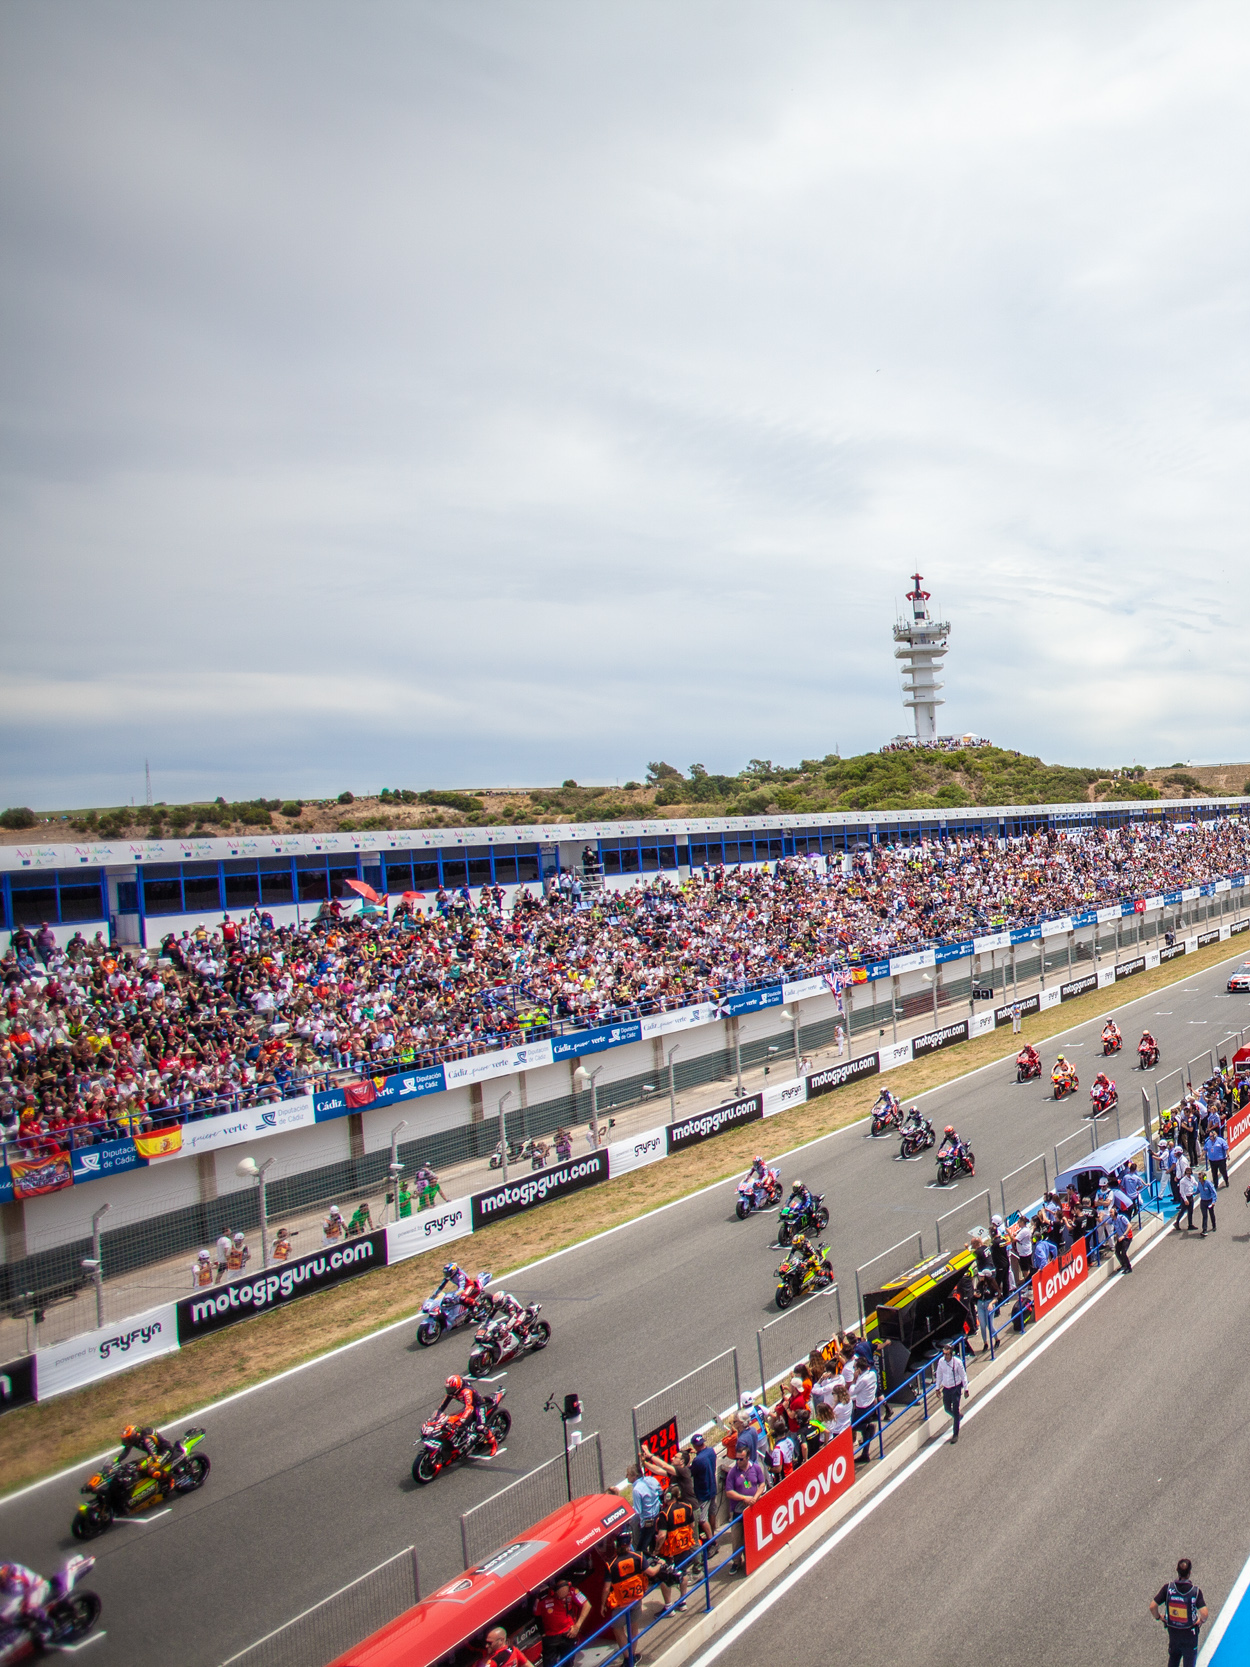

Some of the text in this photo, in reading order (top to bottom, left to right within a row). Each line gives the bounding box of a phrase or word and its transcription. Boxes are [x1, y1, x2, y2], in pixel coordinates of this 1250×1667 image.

[915, 1024, 965, 1049] motogpguru.com
[811, 1056, 875, 1088] motogpguru.com
[316, 1099, 342, 1112] Cádiz
[223, 1122, 248, 1135] verte
[279, 1117, 287, 1125] de
[672, 1099, 757, 1142] motogpguru.com
[102, 1144, 137, 1159] Diputació
[103, 1155, 136, 1169] de Cádiz
[481, 1158, 600, 1214] motogpguru.com
[192, 1240, 374, 1322] motogpguru.com
[1037, 1255, 1083, 1307] Lenovo
[55, 1349, 86, 1366] powered
[88, 1346, 97, 1354] by
[755, 1455, 847, 1551] Lenovo
[603, 1507, 626, 1526] Lenovo
[576, 1526, 601, 1546] Powered by
[622, 1585, 642, 1599] 278
[516, 1624, 538, 1645] Leno
